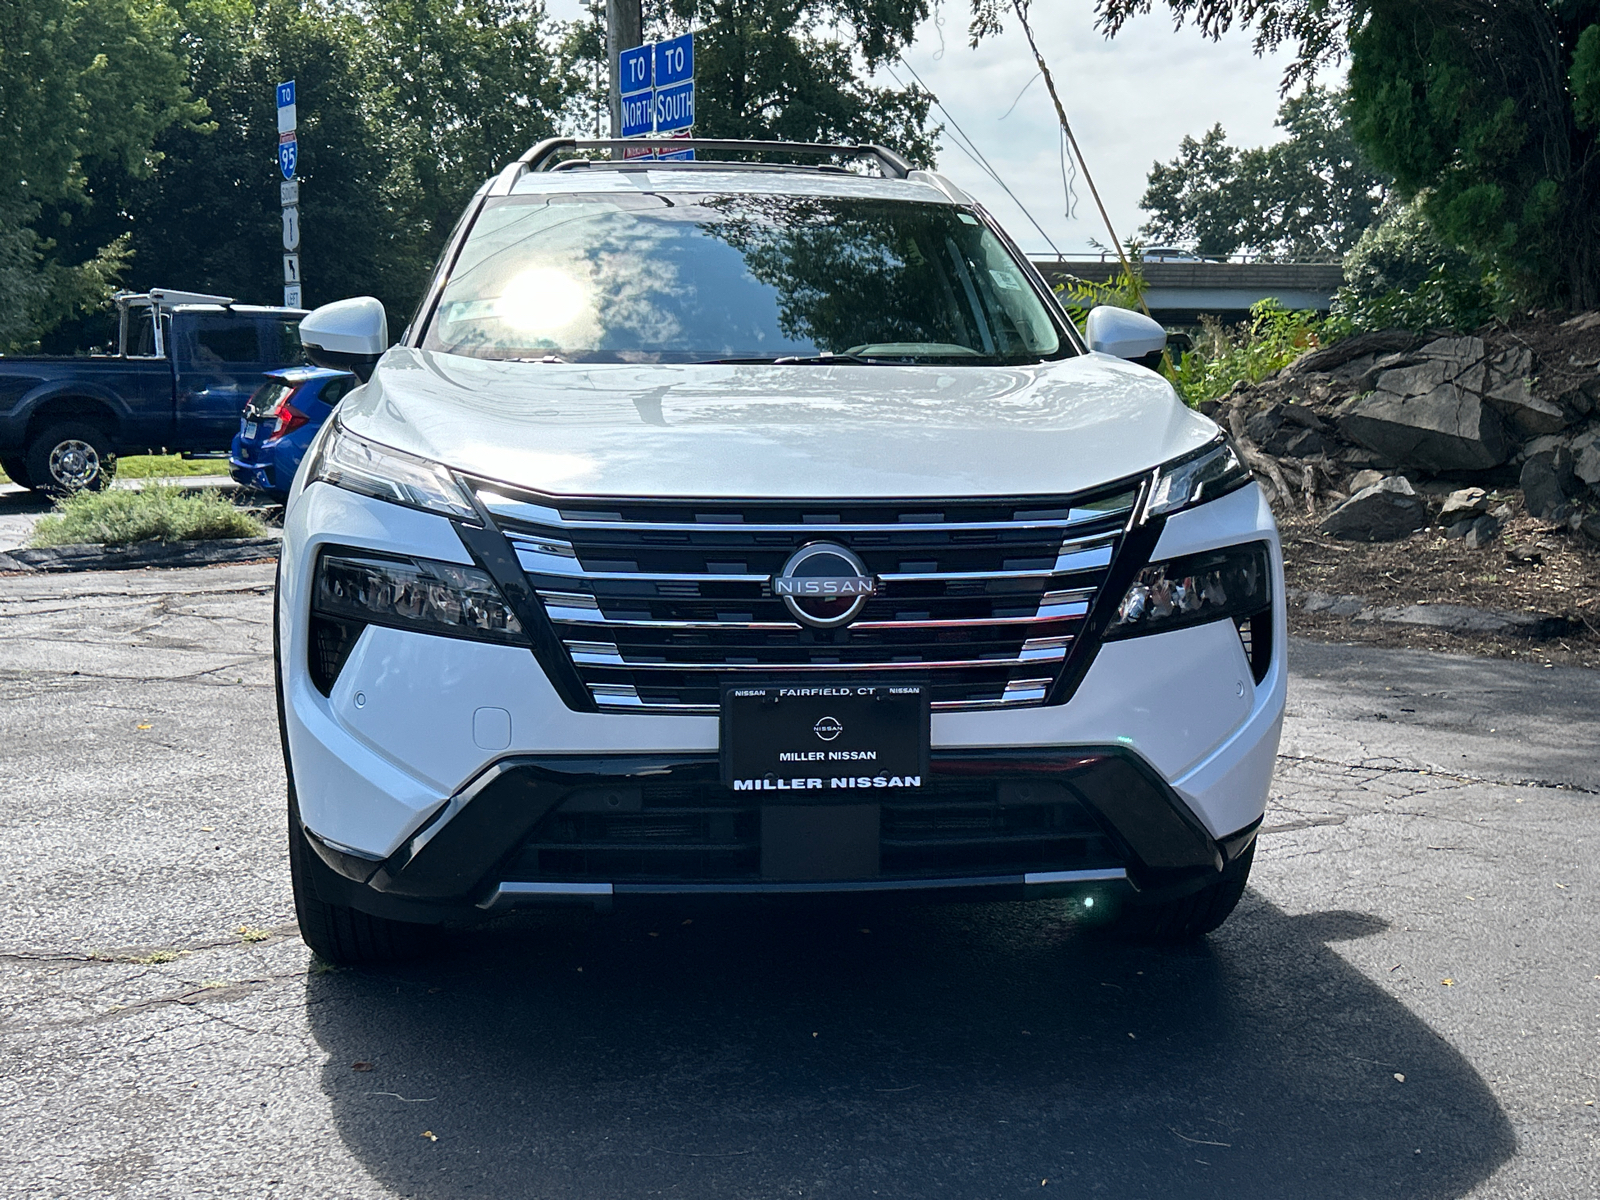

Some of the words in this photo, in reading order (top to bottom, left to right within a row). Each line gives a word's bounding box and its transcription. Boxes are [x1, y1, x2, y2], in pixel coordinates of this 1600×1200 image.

[629, 56, 645, 83] TO
[665, 46, 684, 75] TO
[281, 87, 291, 103] TO
[622, 98, 653, 129] NORTH
[657, 91, 693, 123] SOUTH
[282, 147, 295, 170] 95
[778, 580, 873, 593] NISSAN
[779, 688, 853, 697] FAIRFIELD,
[857, 687, 876, 696] CT
[779, 752, 825, 761] MILLER
[828, 751, 876, 760] NISSAN
[733, 778, 823, 791] MILLER
[830, 776, 921, 789] NISSAN
